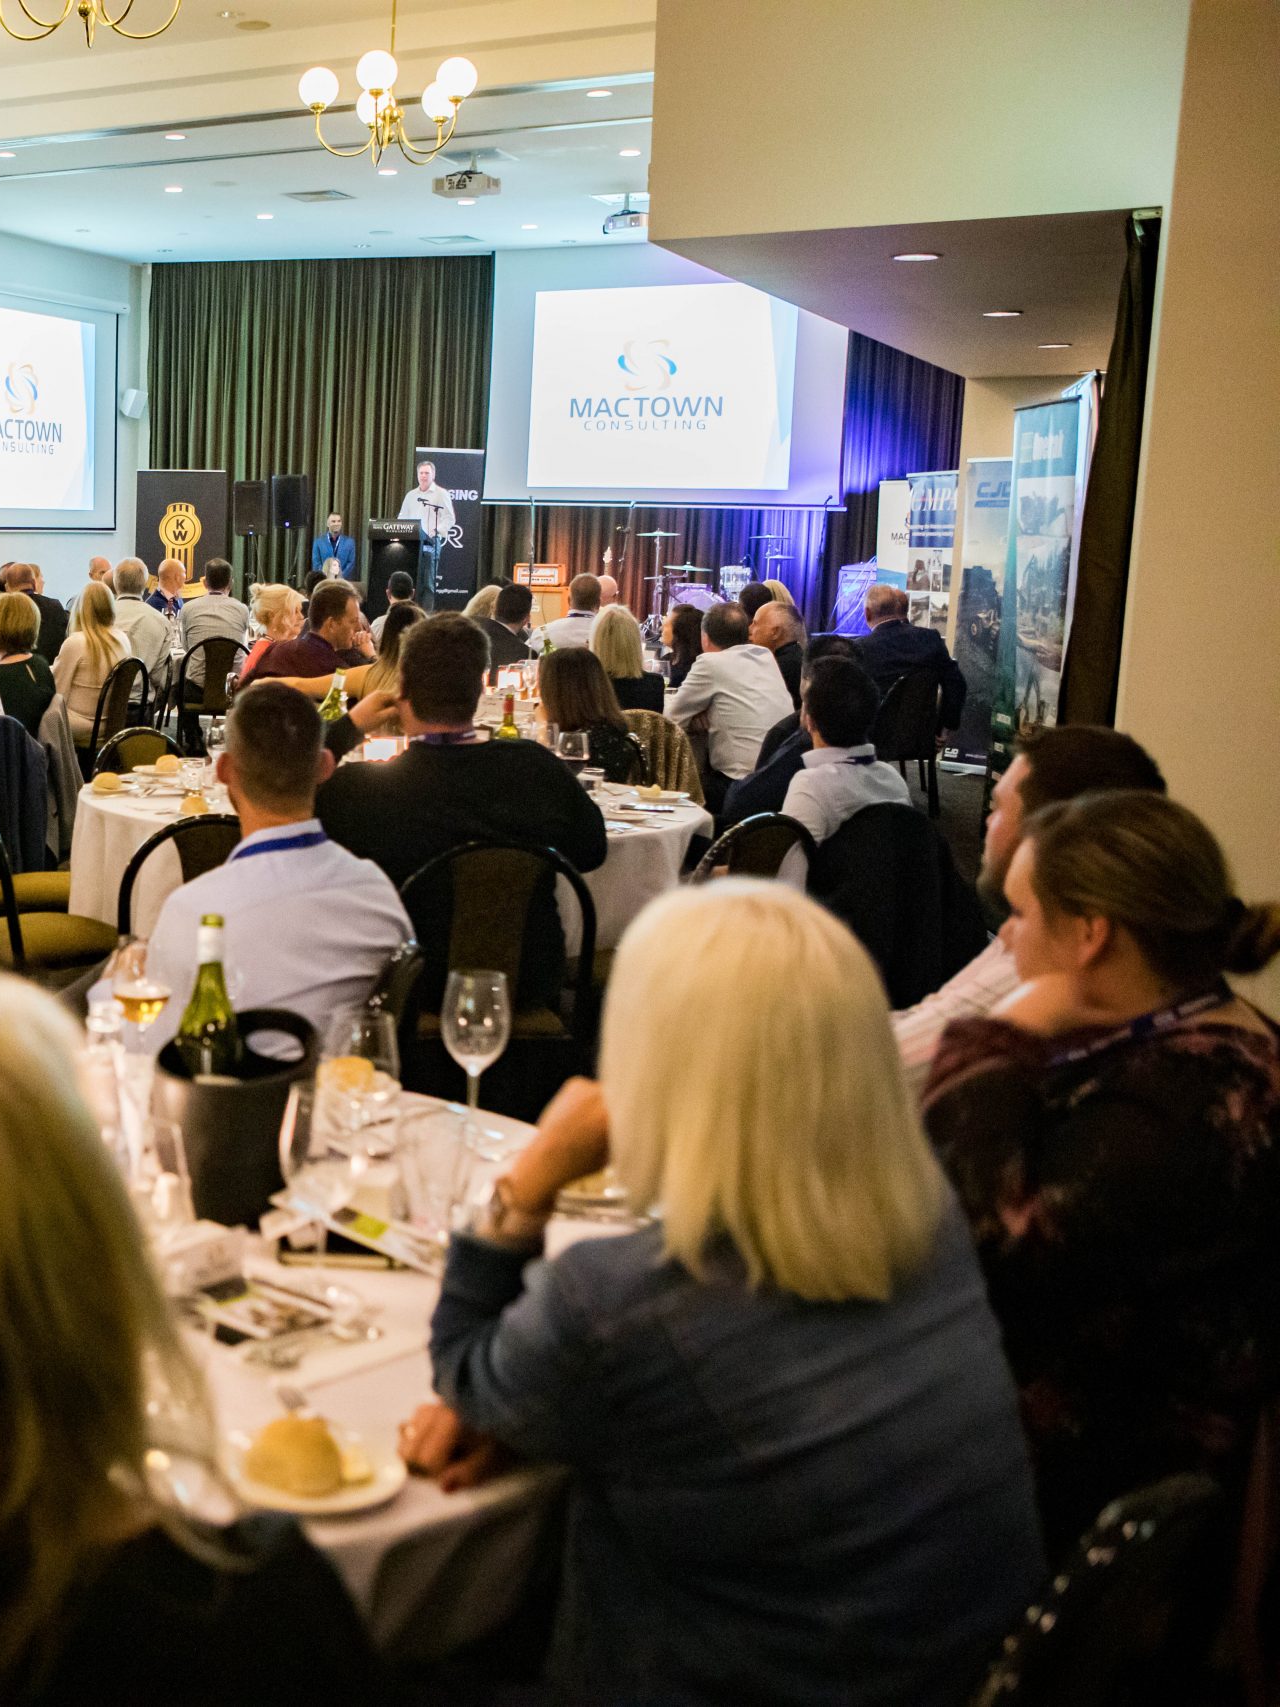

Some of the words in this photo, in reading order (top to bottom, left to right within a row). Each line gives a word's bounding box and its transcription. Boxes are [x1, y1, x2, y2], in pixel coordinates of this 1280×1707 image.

[570, 396, 724, 418] MACTOWN
[583, 419, 707, 431] CONSULTING
[383, 522, 415, 530] GATEWAY
